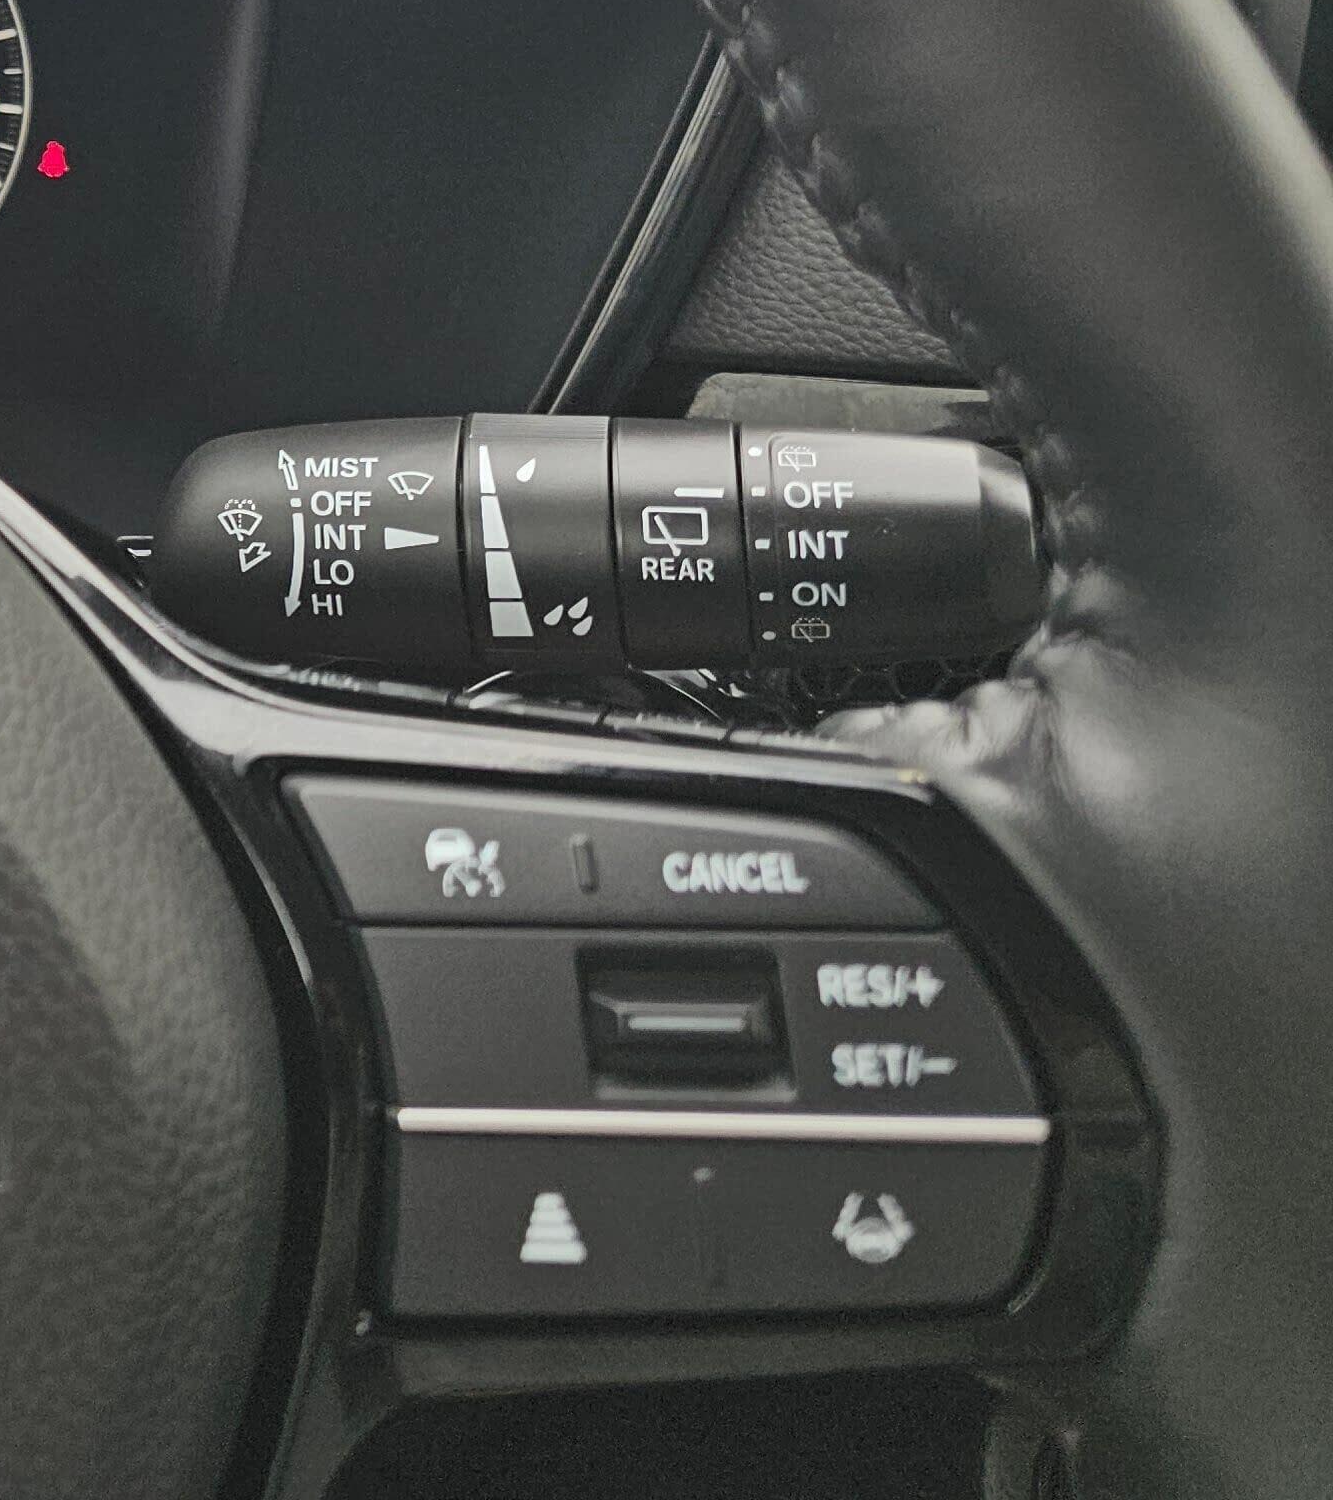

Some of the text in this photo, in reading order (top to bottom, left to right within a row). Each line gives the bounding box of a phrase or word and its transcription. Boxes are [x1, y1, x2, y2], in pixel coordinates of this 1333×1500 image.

[304, 457, 379, 479] MIST
[310, 490, 373, 517] OFF
[783, 481, 854, 510] OFF
[314, 524, 367, 551] INT
[787, 530, 850, 560] INT
[312, 560, 355, 587] LO
[641, 558, 715, 582] REAR
[310, 595, 344, 617] HI
[791, 582, 848, 607] ON
[661, 850, 809, 896] CANCEL
[815, 963, 945, 1008] RES/+
